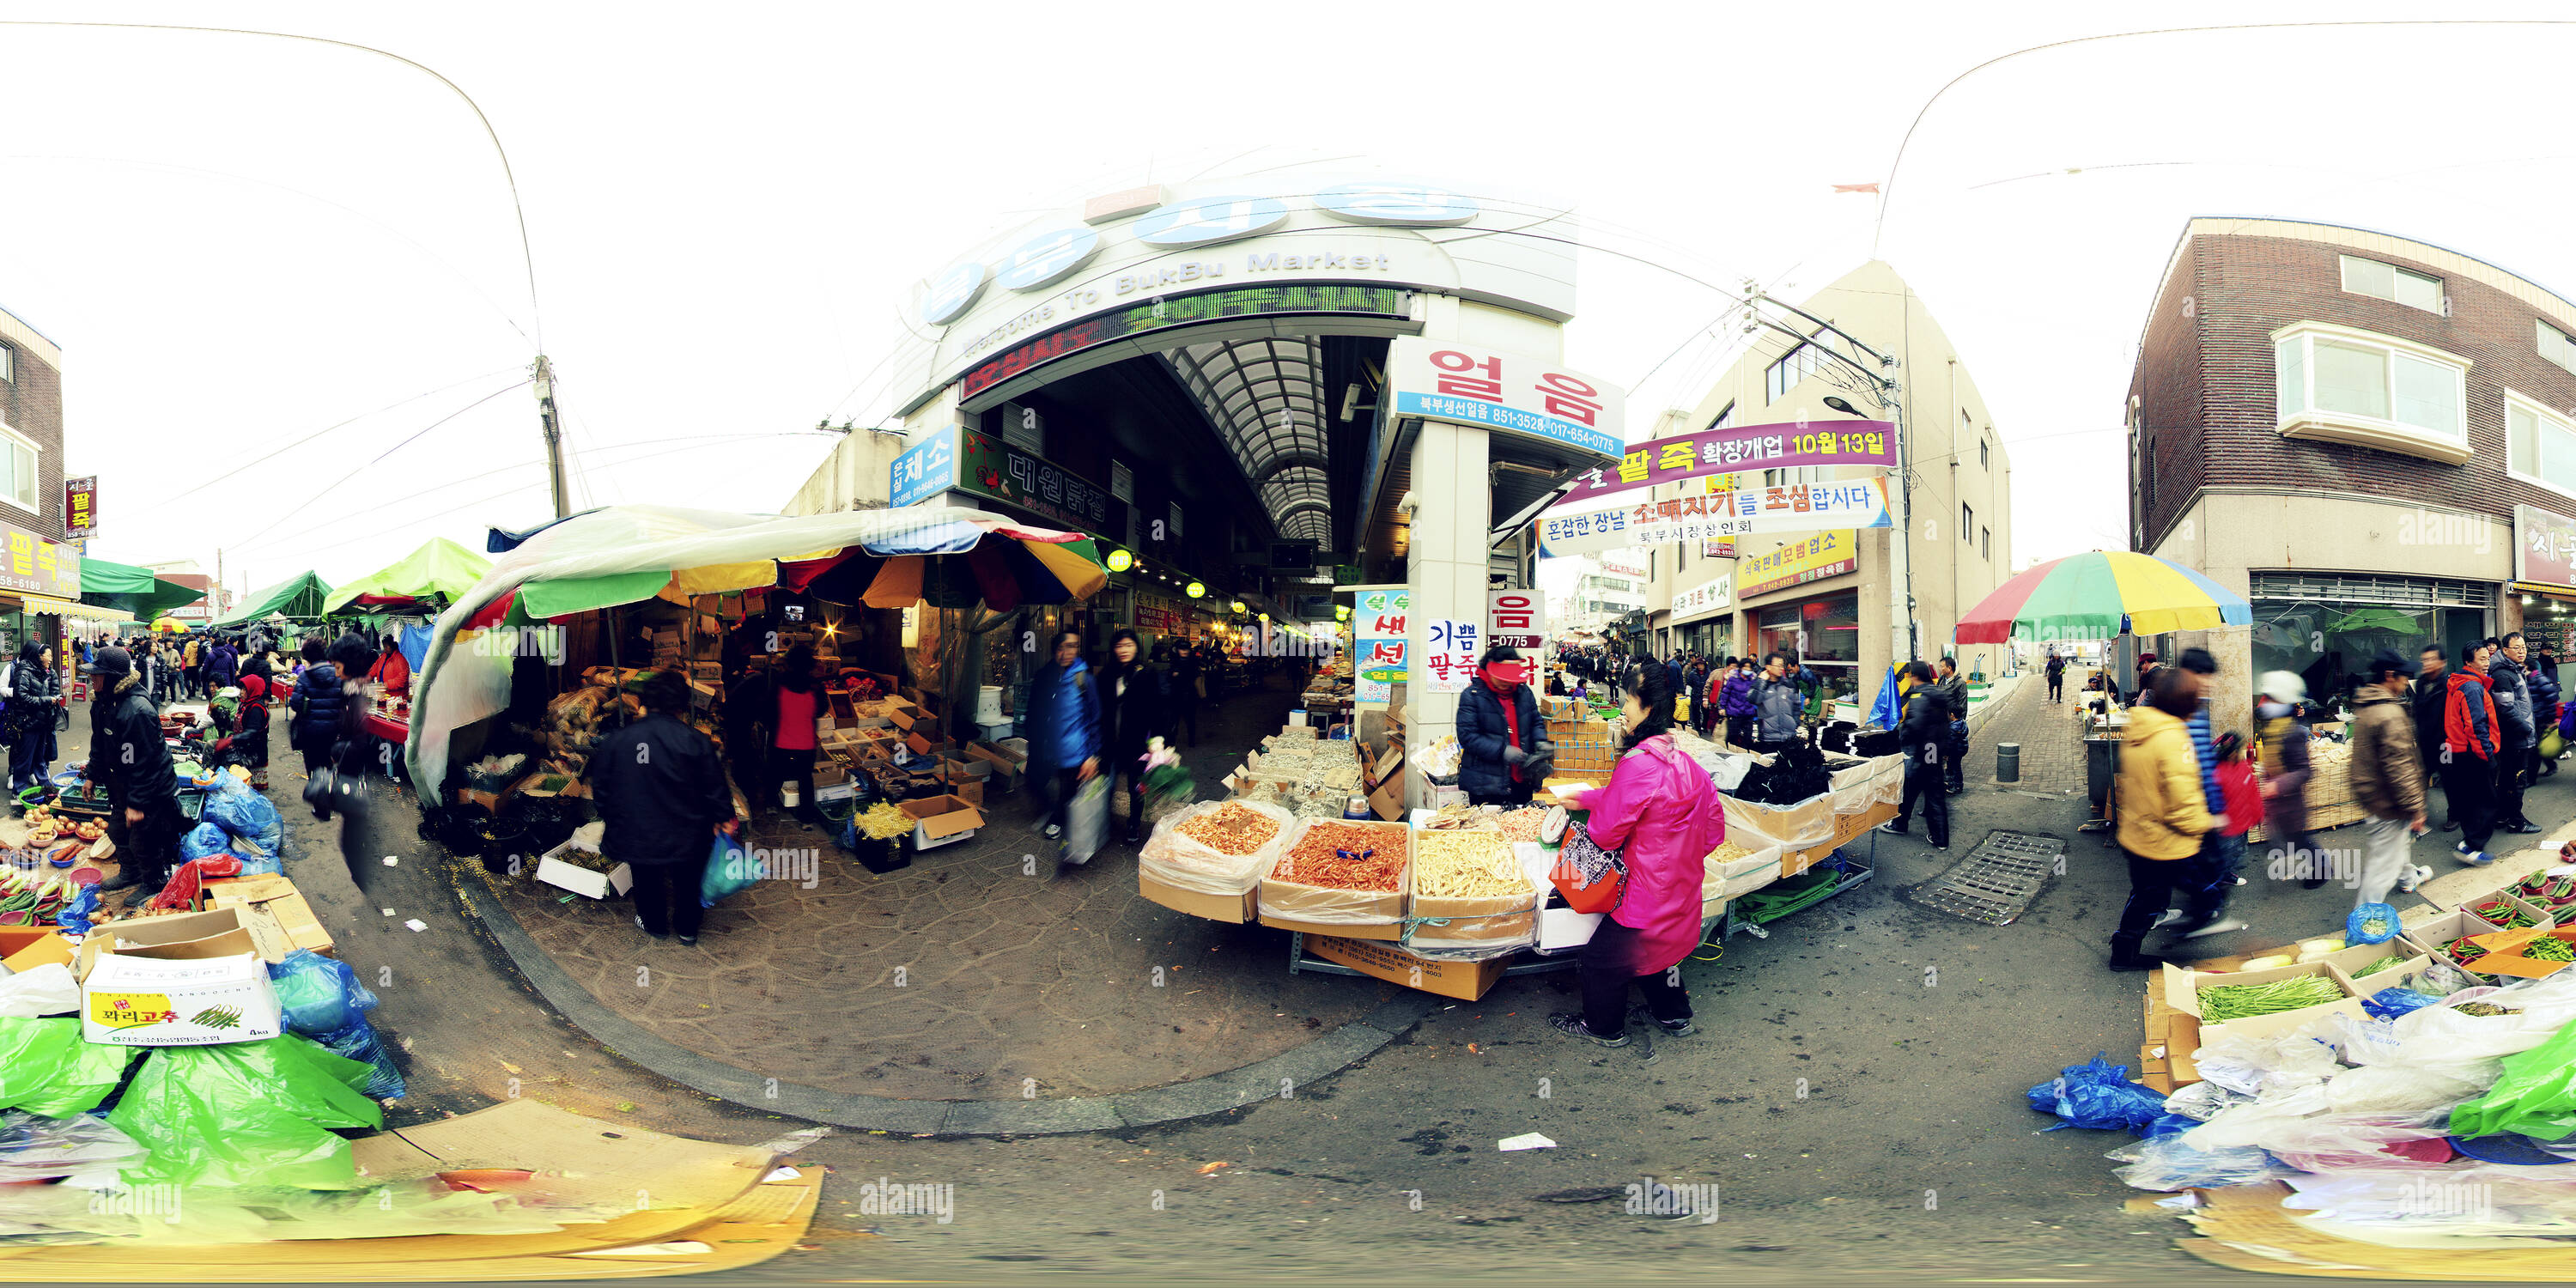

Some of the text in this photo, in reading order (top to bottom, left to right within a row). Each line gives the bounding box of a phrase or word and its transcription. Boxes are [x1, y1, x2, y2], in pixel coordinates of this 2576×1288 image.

[962, 305, 1054, 357] Welcome
[1065, 289, 1099, 310] To
[1115, 261, 1224, 296] BukBu
[1248, 252, 1388, 272] Market
[1419, 396, 1488, 420] 북부생선얼음
[1550, 421, 1614, 453] 017-654-0775
[904, 439, 950, 485] 채소
[1701, 434, 1783, 465] 확장개업
[1791, 431, 1838, 456] 10월
[1840, 431, 1885, 455] 13일
[1007, 453, 1105, 523] 대원닭집
[72, 492, 90, 529] 팥죽
[1546, 513, 1590, 542] 혼잡한
[1594, 510, 1625, 535] 장날
[1765, 484, 1871, 513] 조심합시다
[1639, 519, 1752, 543] 북부시장상인회
[9, 531, 58, 582] 팥죽
[1492, 595, 1534, 629] 음
[1429, 619, 1478, 652] 기쁨
[1427, 652, 1479, 681] 팥죽
